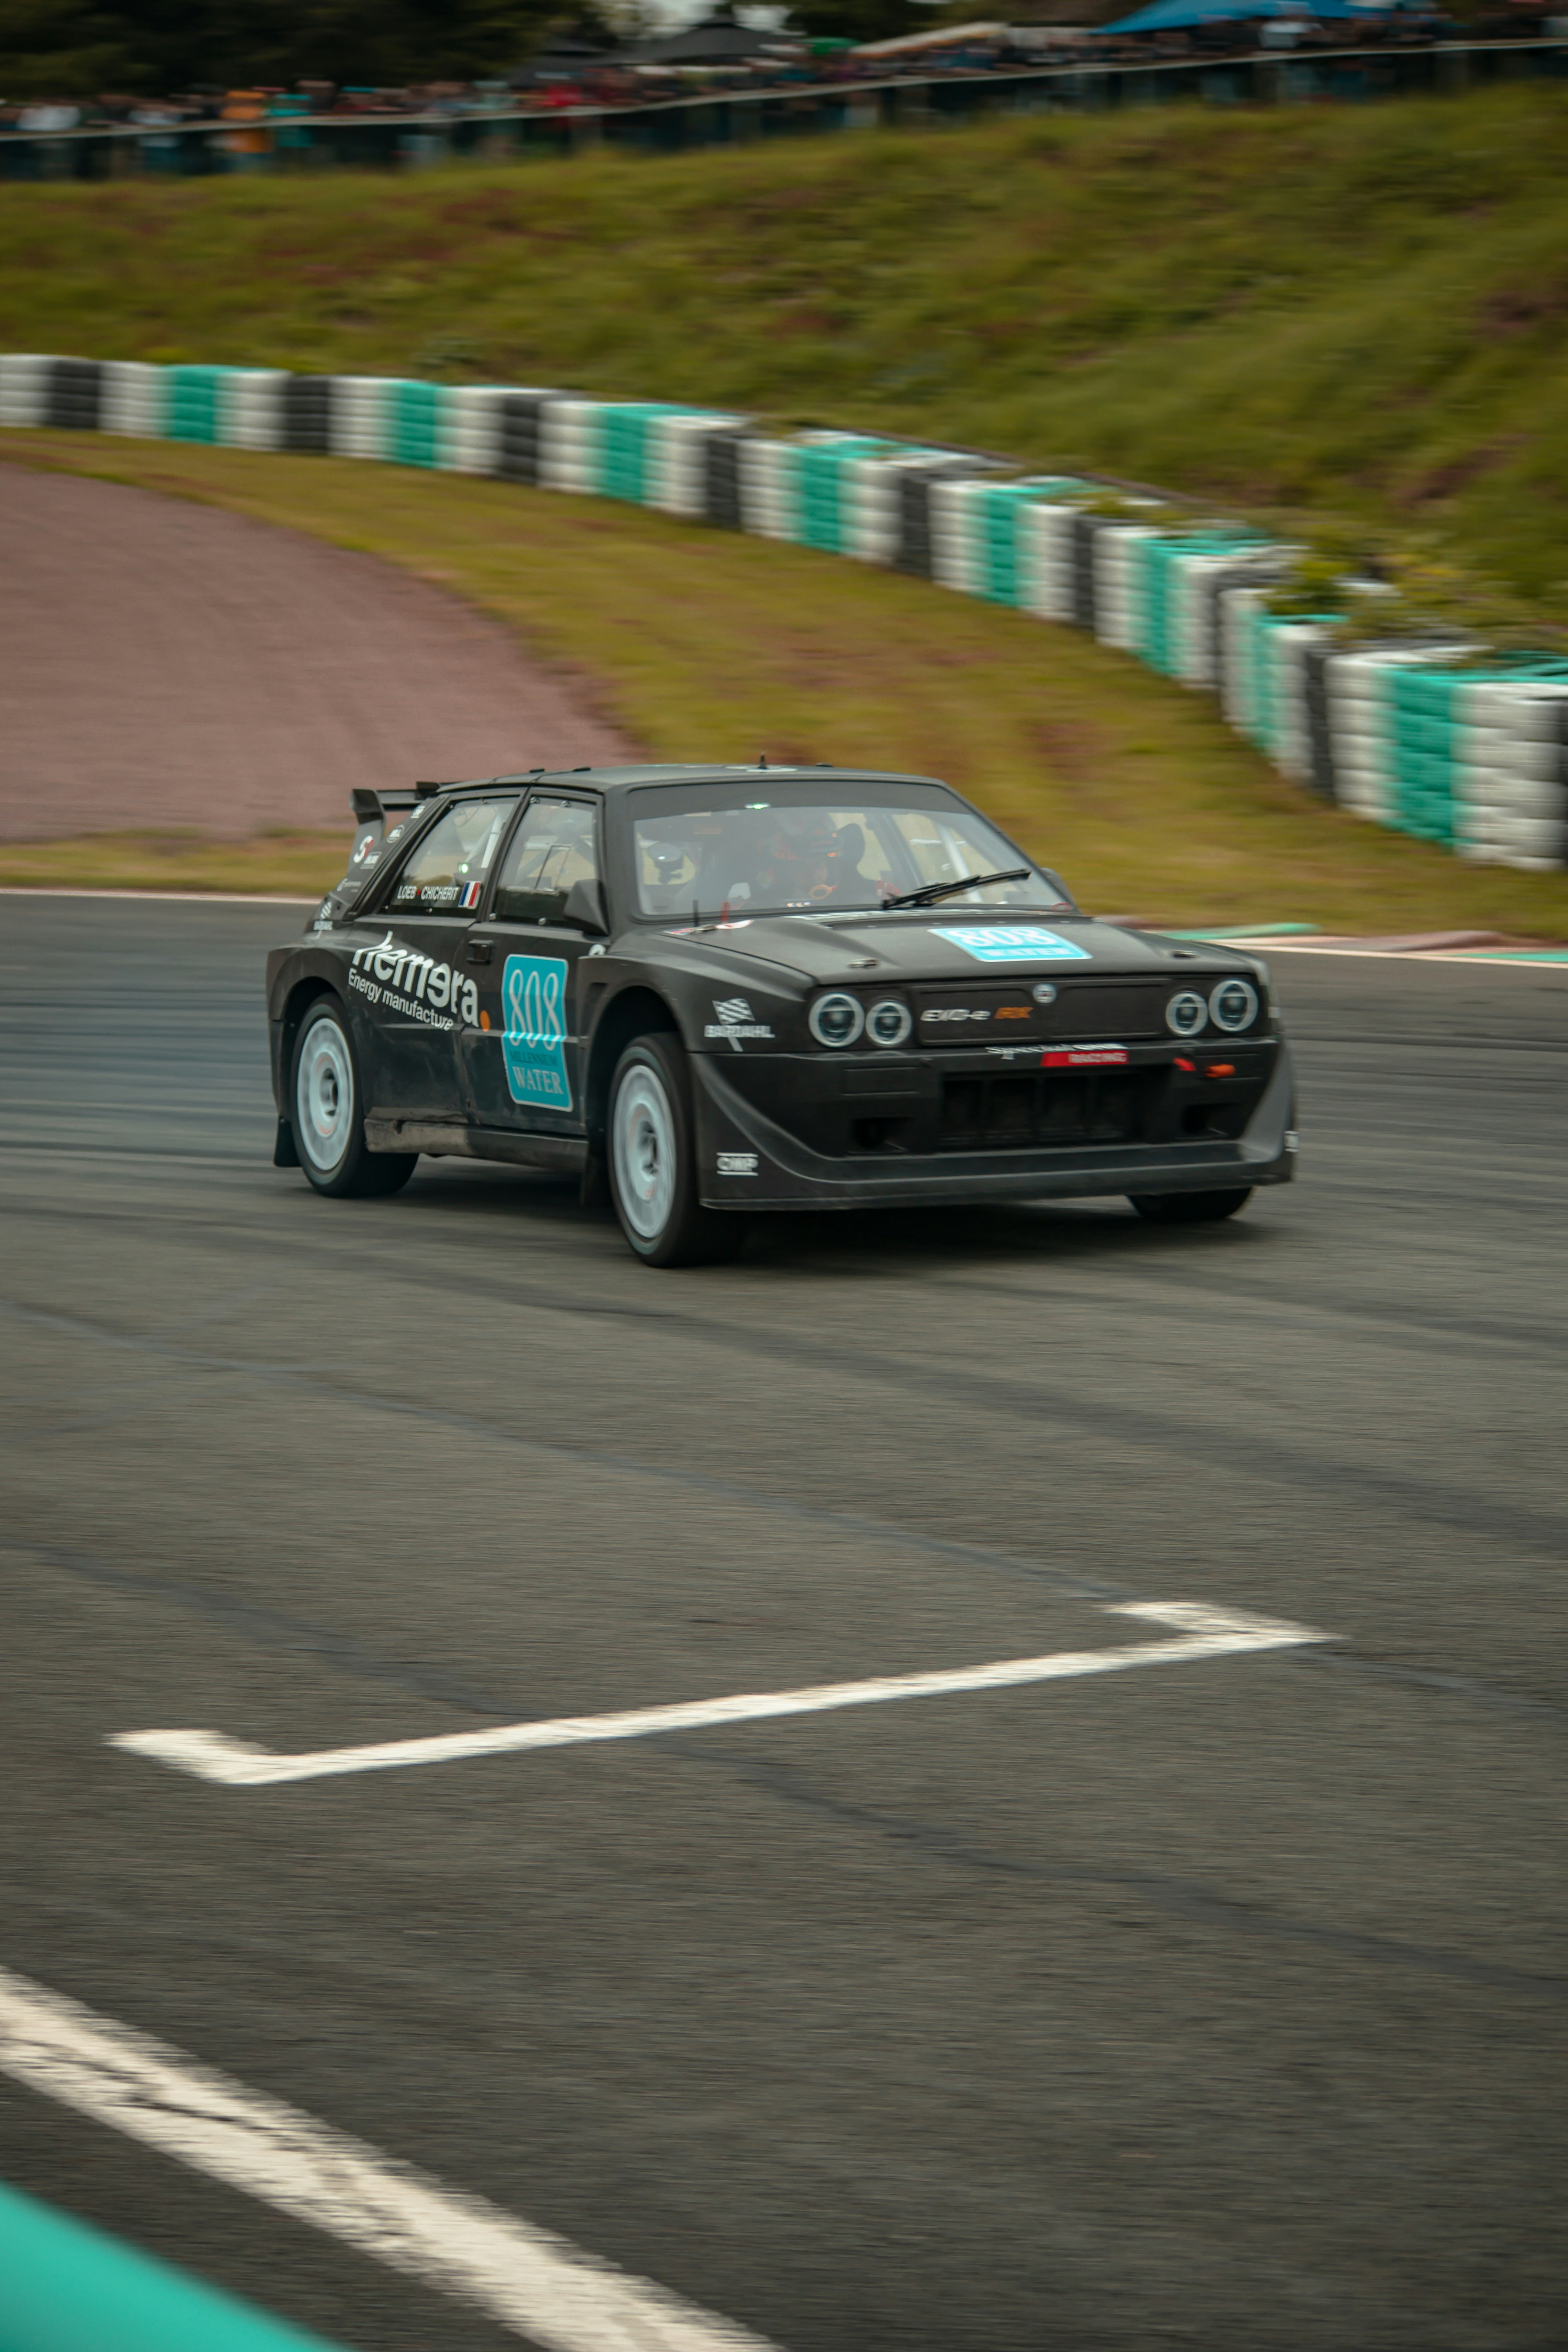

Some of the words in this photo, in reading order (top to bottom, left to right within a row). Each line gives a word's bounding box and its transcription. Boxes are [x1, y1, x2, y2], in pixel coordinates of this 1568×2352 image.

[397, 885, 417, 899] LOEB
[421, 885, 459, 900] CHICHERIT
[947, 929, 1058, 946] 808
[348, 967, 382, 1003] Energy
[382, 989, 454, 1031] manufacture
[509, 969, 562, 1051] 808
[512, 1066, 564, 1095] WATER
